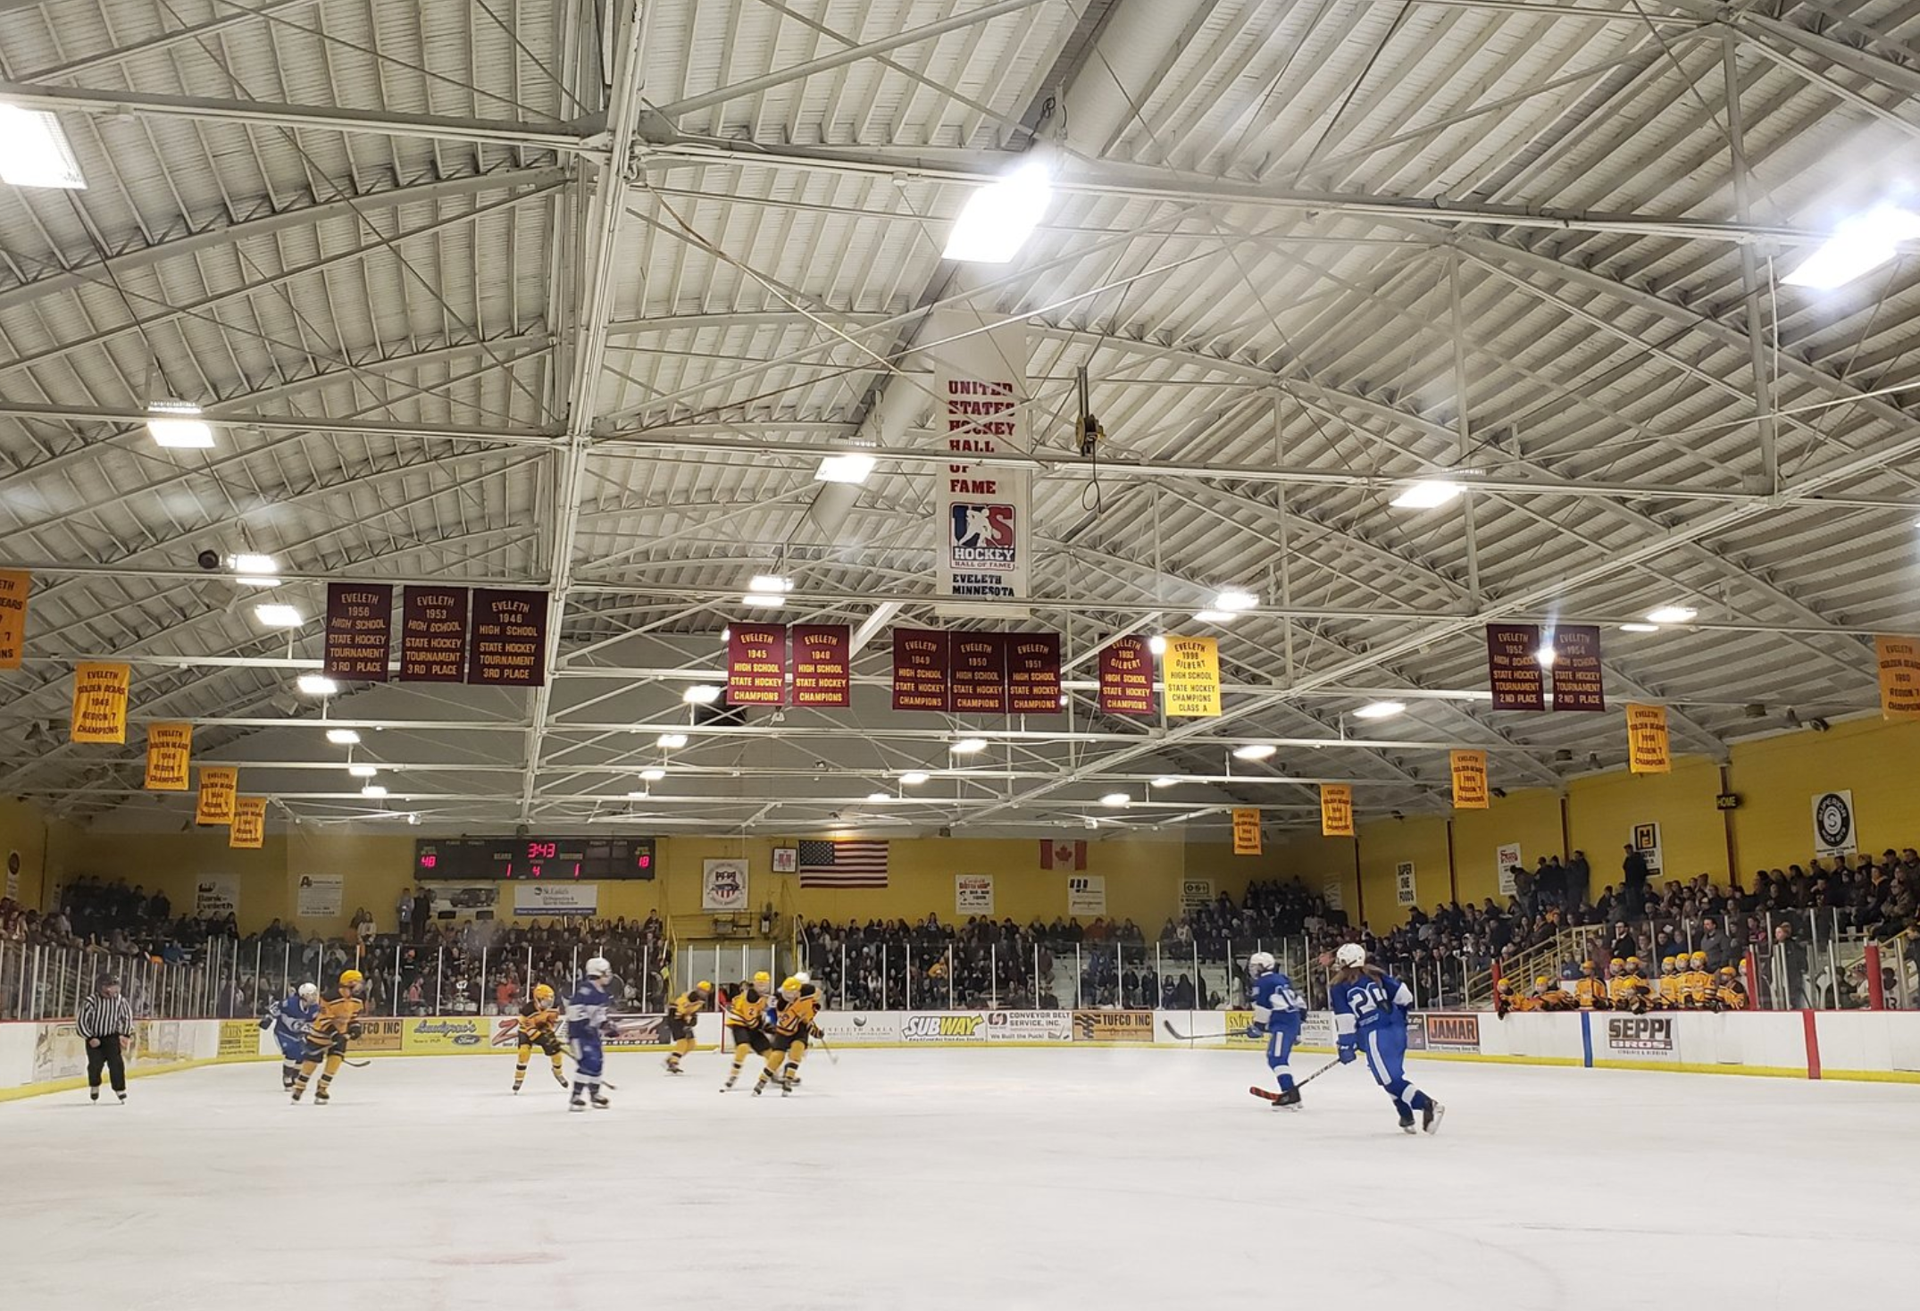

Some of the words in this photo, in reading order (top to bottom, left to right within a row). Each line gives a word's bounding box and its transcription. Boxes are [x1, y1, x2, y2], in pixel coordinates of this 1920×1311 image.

[949, 380, 1013, 396] UNITED
[948, 400, 1015, 417] STATES
[949, 420, 1015, 436] HOCKEY
[949, 440, 994, 453] HALL
[950, 479, 996, 494] FAME
[954, 548, 1014, 560] HOCKEY
[952, 573, 1002, 584] EVELETH
[952, 585, 1015, 597] MINNESOTA
[341, 593, 379, 605] EVELETH
[417, 595, 455, 606] EVELETH
[492, 600, 530, 613] EVELETH
[426, 609, 447, 619] 1953
[331, 617, 352, 629] HIGH
[355, 619, 386, 630] SCHOOL
[408, 619, 428, 631] HIGH
[430, 622, 462, 632] SCHOOL
[479, 625, 500, 635] HIGH
[506, 625, 538, 636] SCHOOL
[329, 634, 352, 644] STATE
[355, 634, 386, 645] HOCKEY
[405, 637, 429, 647] STATE
[431, 638, 462, 648] HOCKEY
[740, 633, 774, 644] EVELETH
[804, 634, 838, 645] EVELETH
[1498, 633, 1529, 642] EVELETH
[1559, 633, 1590, 643] EVELETH
[479, 642, 503, 652] STATE
[505, 643, 537, 653] HOCKEY
[905, 640, 937, 653] EVELETH
[960, 643, 992, 653] EVELETH
[1017, 643, 1049, 654] EVELETH
[1112, 639, 1141, 650] EVELETH
[1174, 641, 1206, 652] EVELETH
[330, 648, 385, 658] TOURNAMENT
[406, 651, 461, 662] TOURNAMENT
[747, 650, 767, 658] 1945
[480, 655, 535, 666] TOURNAMENT
[1110, 658, 1141, 669] GILBERT
[1176, 660, 1206, 669] GILBERT
[1493, 655, 1509, 665] HIGH
[1512, 656, 1537, 666] SCHOOL
[1573, 657, 1598, 667] SCHOOL
[356, 662, 381, 672] PLACE
[432, 664, 457, 675] PLACE
[734, 663, 751, 672] HIGH
[753, 663, 780, 673] SCHOOL
[798, 664, 814, 673] HIGH
[816, 665, 843, 674] SCHOOL
[87, 671, 119, 679] EVELETH
[483, 668, 500, 678] 3RD
[504, 669, 530, 679] PLACE
[899, 668, 915, 678] HIGH
[917, 669, 942, 679] SCHOOL
[956, 670, 972, 680] HIGH
[974, 671, 999, 680] SCHOOL
[1013, 672, 1029, 681] HIGH
[1030, 672, 1056, 681] SCHOOL
[1105, 673, 1120, 682] HIGH
[1123, 674, 1147, 684] SCHOOL
[1171, 672, 1186, 680] HIGH
[1188, 672, 1213, 680] SCHOOL
[1493, 670, 1512, 679] STATE
[1514, 671, 1539, 680] HOCKEY
[1554, 671, 1572, 680] STATE
[1575, 671, 1600, 680] HOCKEY
[731, 677, 752, 686] STATE
[754, 678, 782, 687] HOCKEY
[796, 678, 816, 687] STATE
[819, 678, 846, 688] HOCKEY
[895, 682, 915, 691] STATE
[918, 683, 945, 693] HOCKEY
[1495, 682, 1539, 691] TOURNAMENT
[1556, 682, 1600, 692] TOURNAMENT
[78, 684, 102, 694] GOLDEN
[104, 684, 125, 694] BEARS
[953, 685, 974, 694] STATE
[976, 685, 1003, 695] HOCKEY
[1010, 685, 1029, 695] STATE
[1032, 685, 1059, 695] HOCKEY
[1103, 687, 1122, 696] STATE
[1125, 687, 1150, 697] HOCKEY
[1168, 683, 1188, 692] STATE
[1191, 684, 1215, 693] HOCKEY
[734, 691, 779, 701] CHAMPIONS
[799, 693, 842, 702] CHAMPIONS
[899, 696, 942, 706] CHAMPIONS
[1172, 693, 1211, 702] CHAMPIONS
[1518, 694, 1537, 703] PLACE
[1580, 695, 1600, 704] PLACE
[957, 698, 999, 708] CHAMPIONS
[1014, 699, 1056, 709] CHAMPIONS
[1107, 700, 1147, 710] CHAMPIONS
[1179, 704, 1199, 712] CLASS
[1203, 704, 1208, 712] A
[82, 711, 108, 721] REGION
[111, 712, 116, 720] 7
[77, 724, 119, 735] CHAMPIONS
[1818, 797, 1847, 821] SUPERIOR
[528, 842, 556, 858] 3:43
[506, 863, 512, 877] 1
[532, 866, 540, 876] 4
[574, 863, 580, 877] 1
[902, 1013, 984, 1038] SUBWAY
[1103, 1014, 1131, 1026] TUFCO
[1135, 1015, 1150, 1026] INC
[384, 1022, 400, 1034] INC
[1431, 1020, 1475, 1039] JAMAR
[1609, 1019, 1672, 1038] SEPPI
[458, 1035, 475, 1043] Ford
